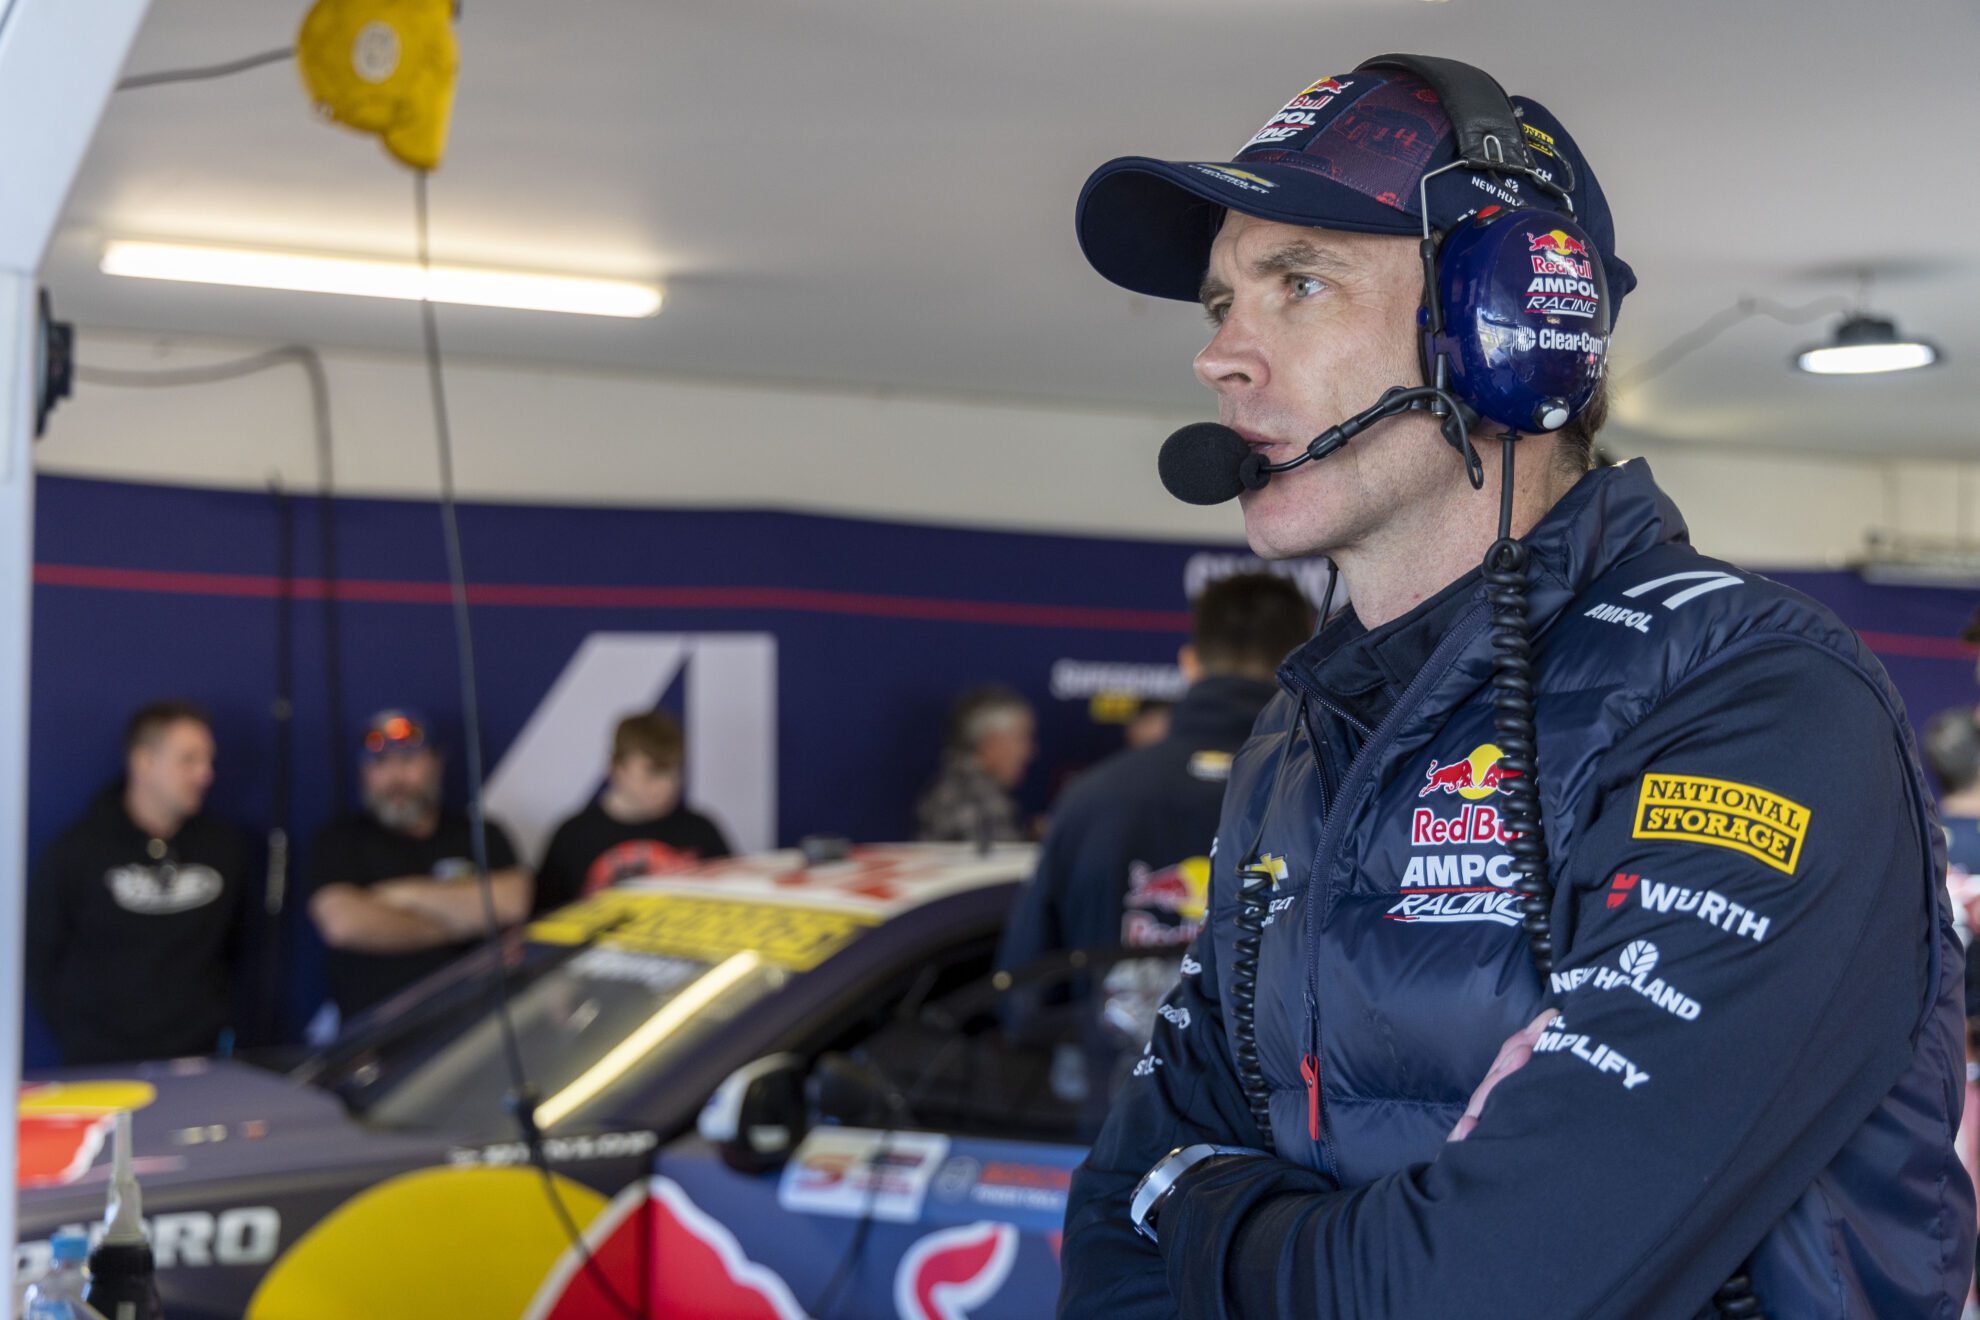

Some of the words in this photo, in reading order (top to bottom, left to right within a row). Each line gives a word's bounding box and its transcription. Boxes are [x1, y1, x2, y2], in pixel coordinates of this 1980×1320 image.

[1471, 176, 1497, 195] NEW
[1527, 277, 1599, 300] AMPOL
[1526, 296, 1597, 314] RACING
[1539, 328, 1604, 355] Clear-Com
[1583, 602, 1653, 634] AMPOL
[1646, 779, 1802, 833] NATIONAL
[1646, 807, 1791, 860] STORAGE
[1400, 854, 1533, 888] AMPO
[1533, 1030, 1650, 1090] MPLIFY
